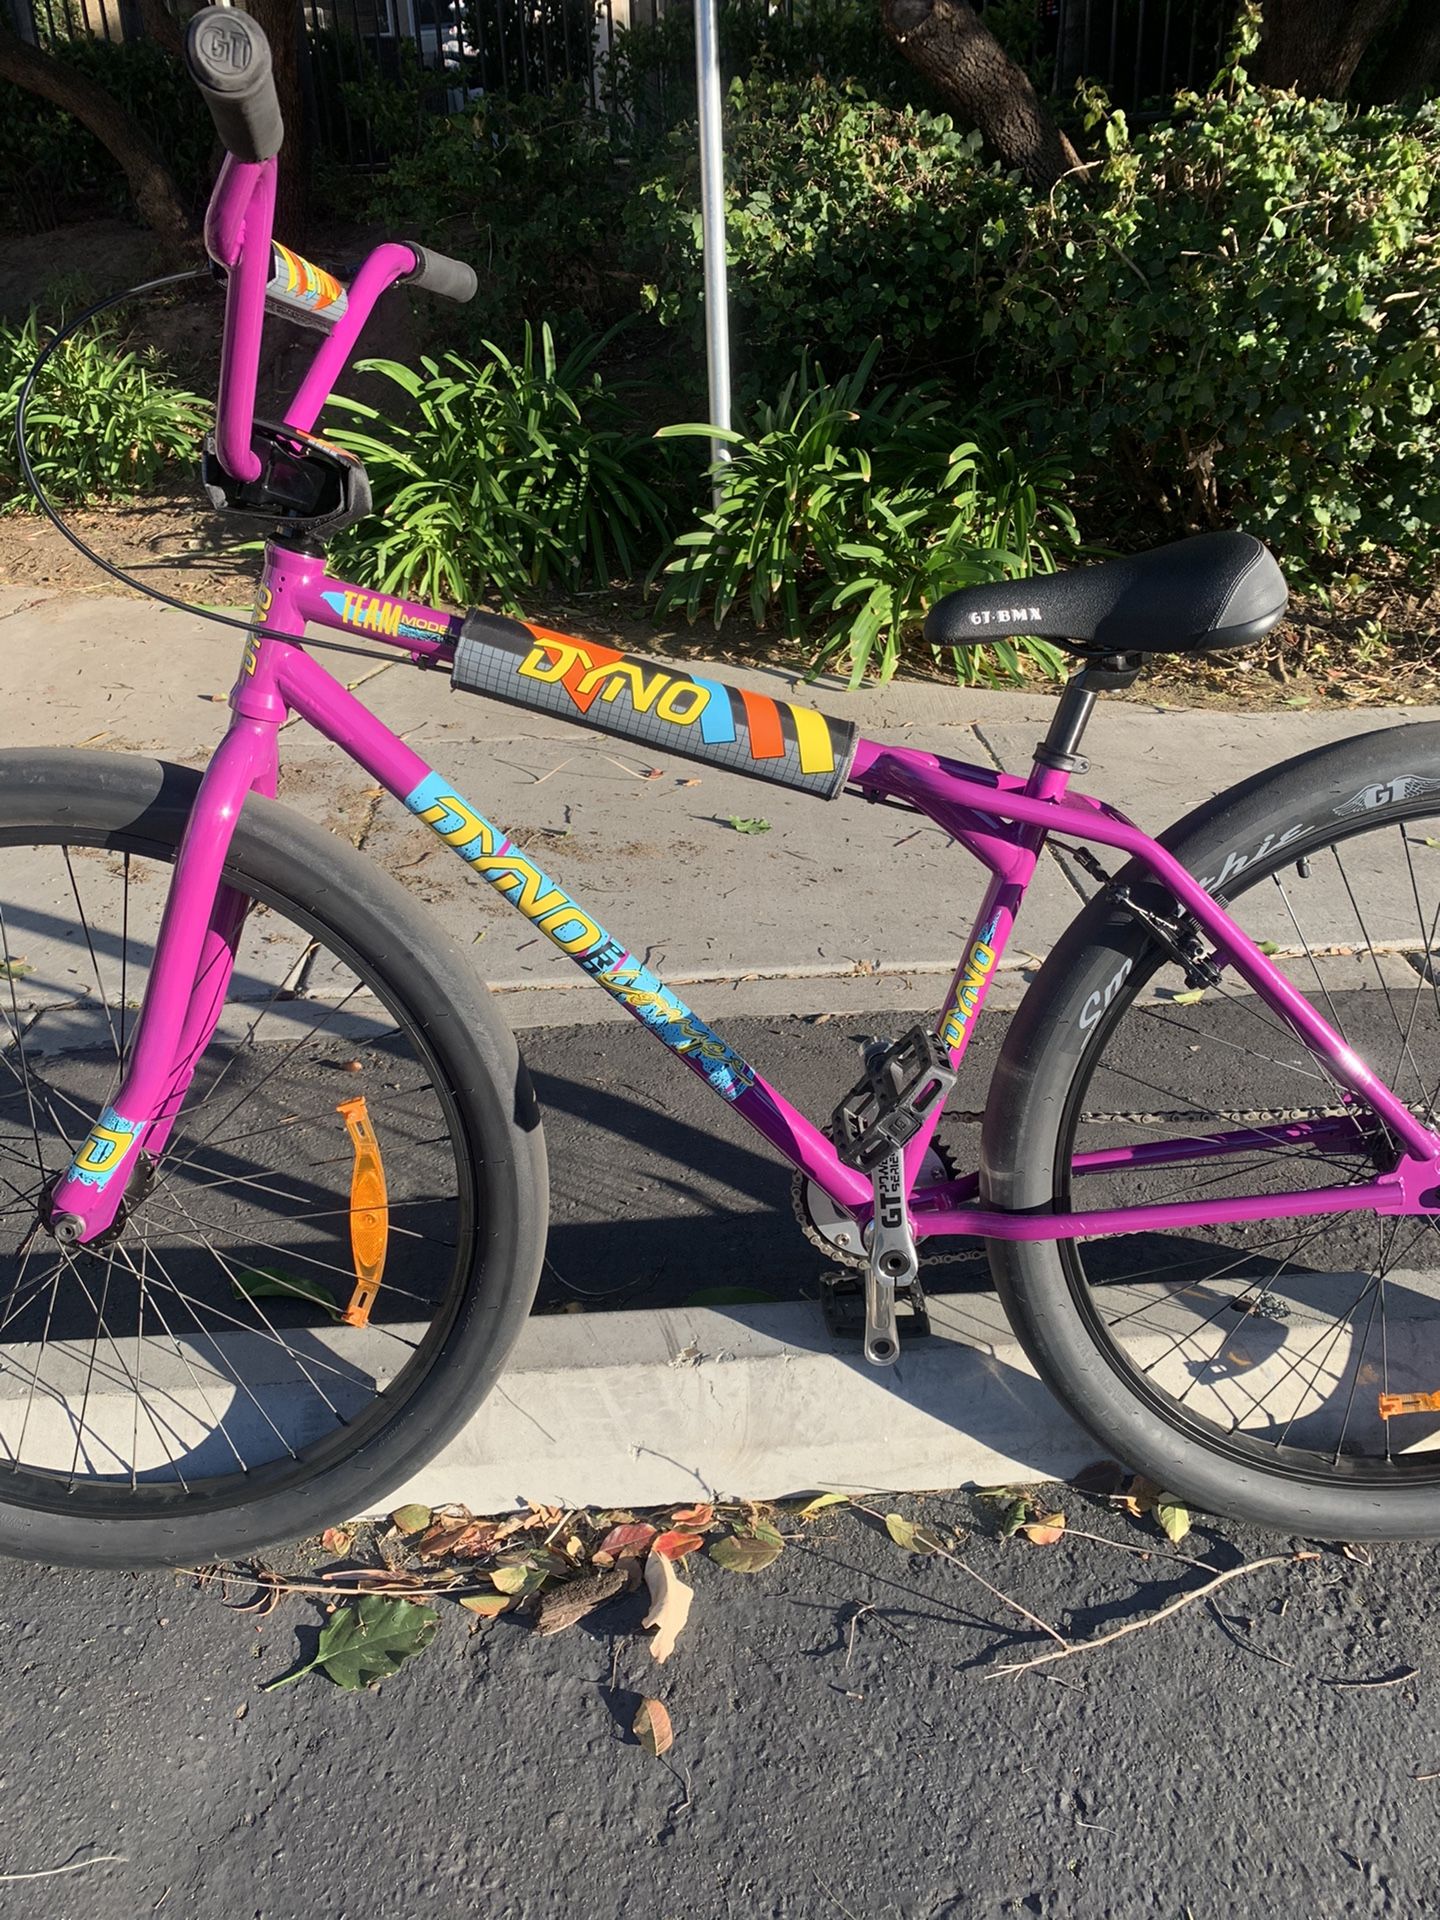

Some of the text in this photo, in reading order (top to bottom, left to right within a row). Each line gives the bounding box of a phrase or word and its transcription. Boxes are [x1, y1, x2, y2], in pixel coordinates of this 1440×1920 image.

[200, 26, 249, 70] GT
[341, 589, 458, 639] TEAM MODEL
[518, 636, 711, 726] DYNO
[414, 795, 602, 955] DYNO
[940, 940, 996, 1049] DYNO
[74, 1124, 134, 1173] D
[889, 1153, 900, 1192] SERIE
[878, 1159, 902, 1228] GT POW
